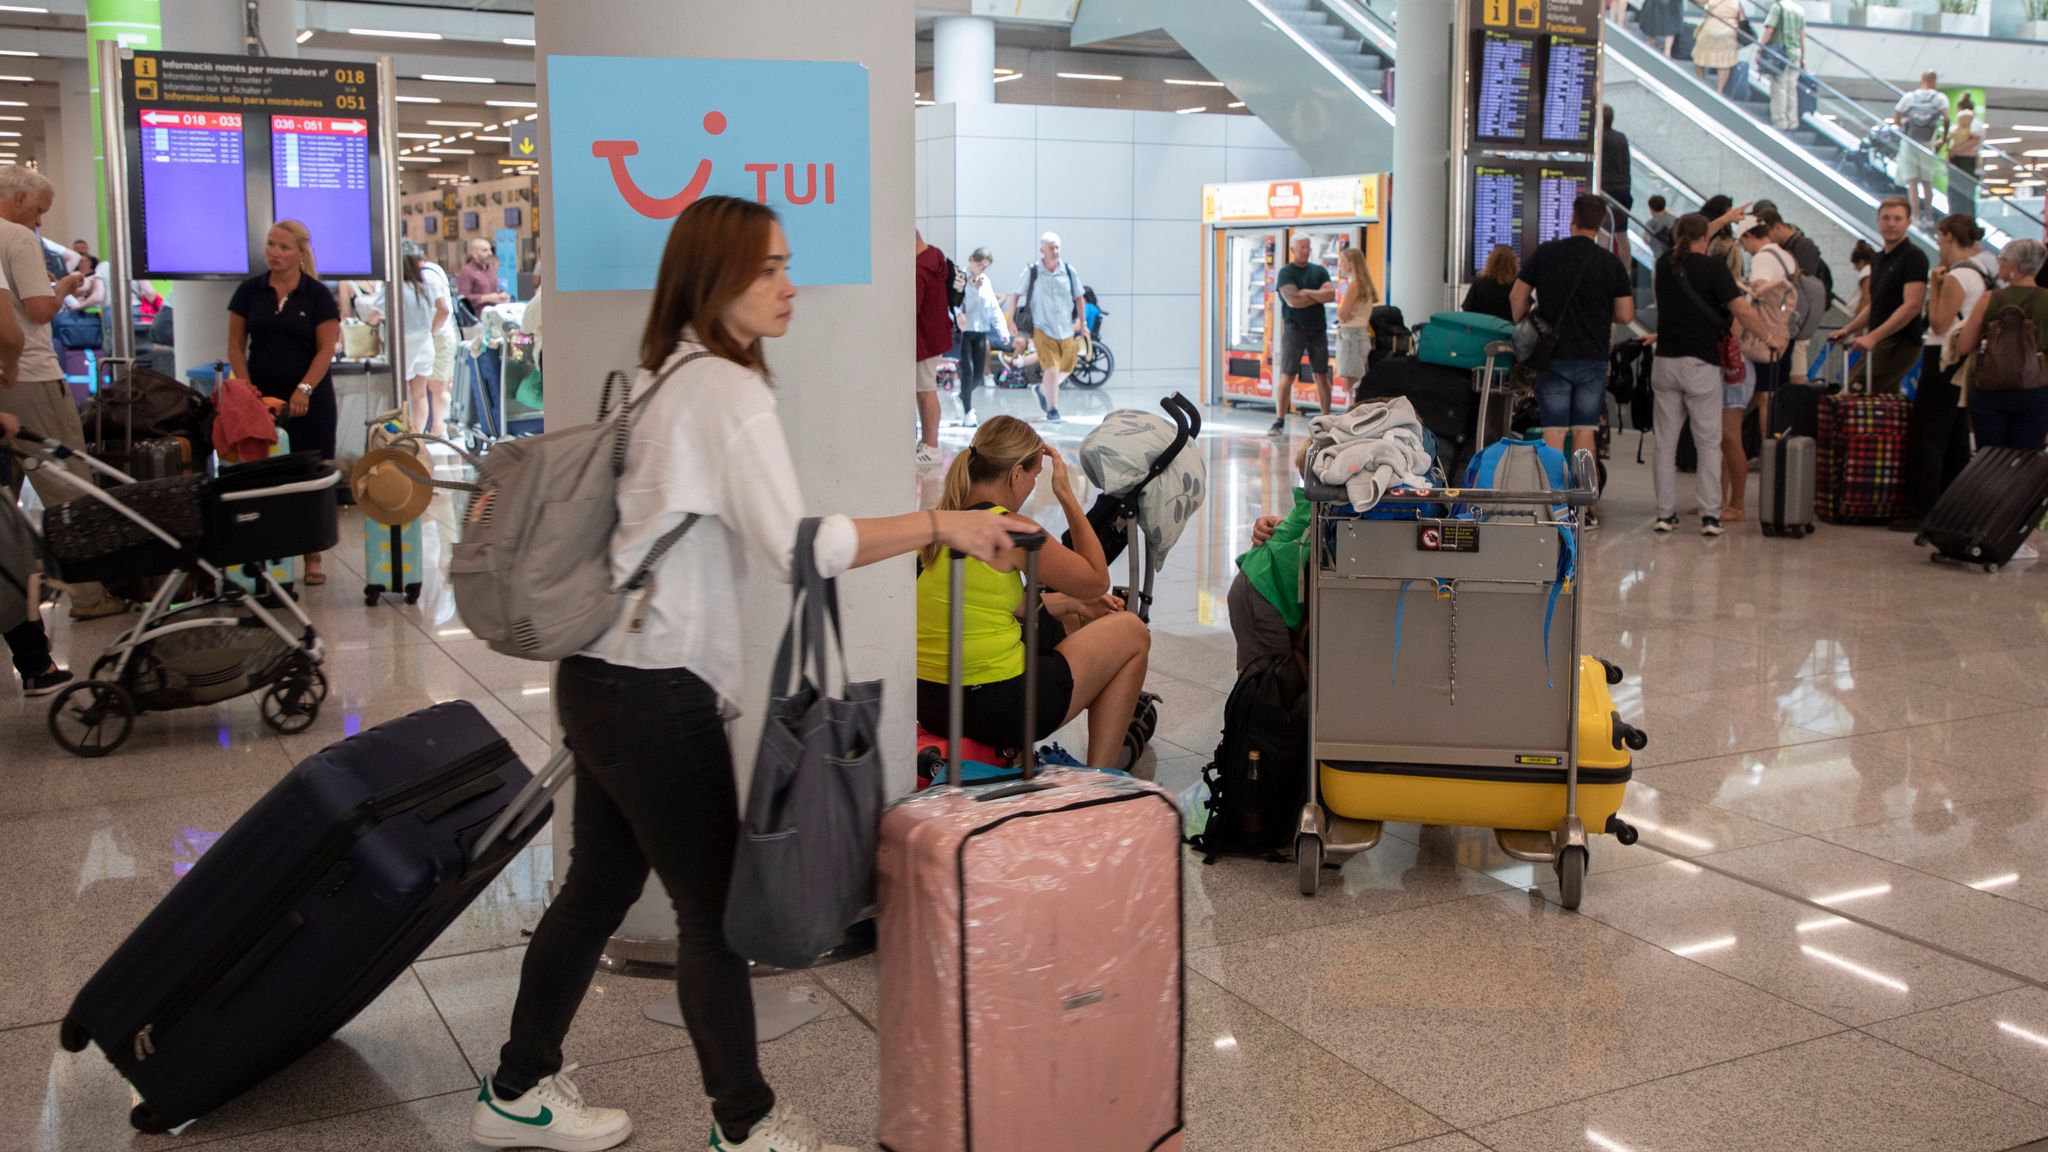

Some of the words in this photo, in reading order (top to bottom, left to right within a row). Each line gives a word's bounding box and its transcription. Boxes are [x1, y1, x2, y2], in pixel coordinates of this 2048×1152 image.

[162, 60, 213, 71] Informació
[215, 63, 246, 73] només
[248, 66, 264, 75] per
[266, 66, 317, 77] mostradors
[335, 69, 365, 84] 018
[336, 94, 366, 110] 051
[183, 114, 206, 125] 018
[219, 116, 242, 127] 033
[303, 120, 323, 131] 051
[744, 163, 834, 205] TUI
